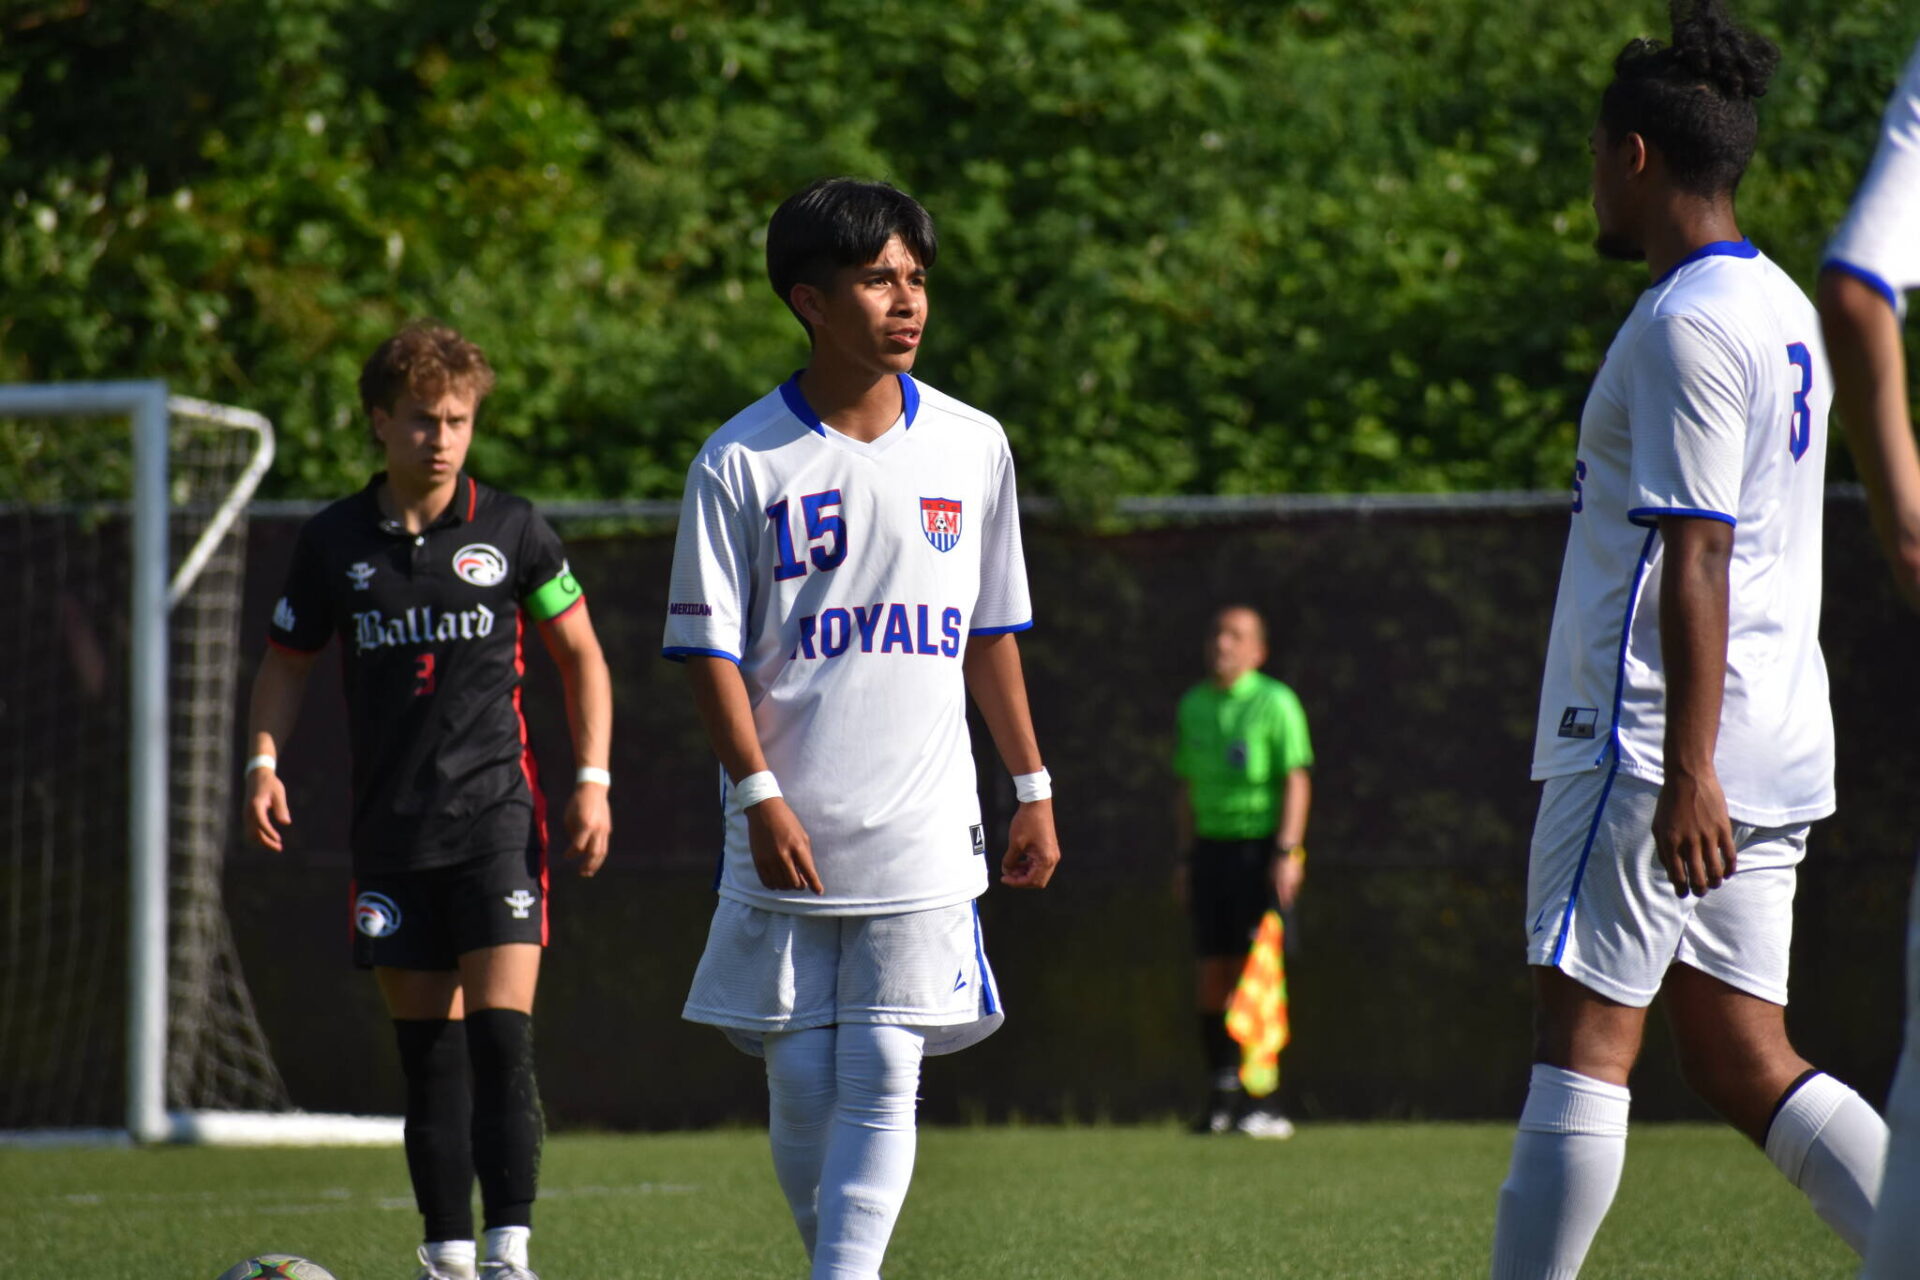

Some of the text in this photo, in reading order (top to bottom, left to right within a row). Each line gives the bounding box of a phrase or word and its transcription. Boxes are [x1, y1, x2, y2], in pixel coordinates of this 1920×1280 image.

[765, 488, 848, 583] 15
[352, 602, 495, 650] Ballard
[414, 652, 436, 696] 3
